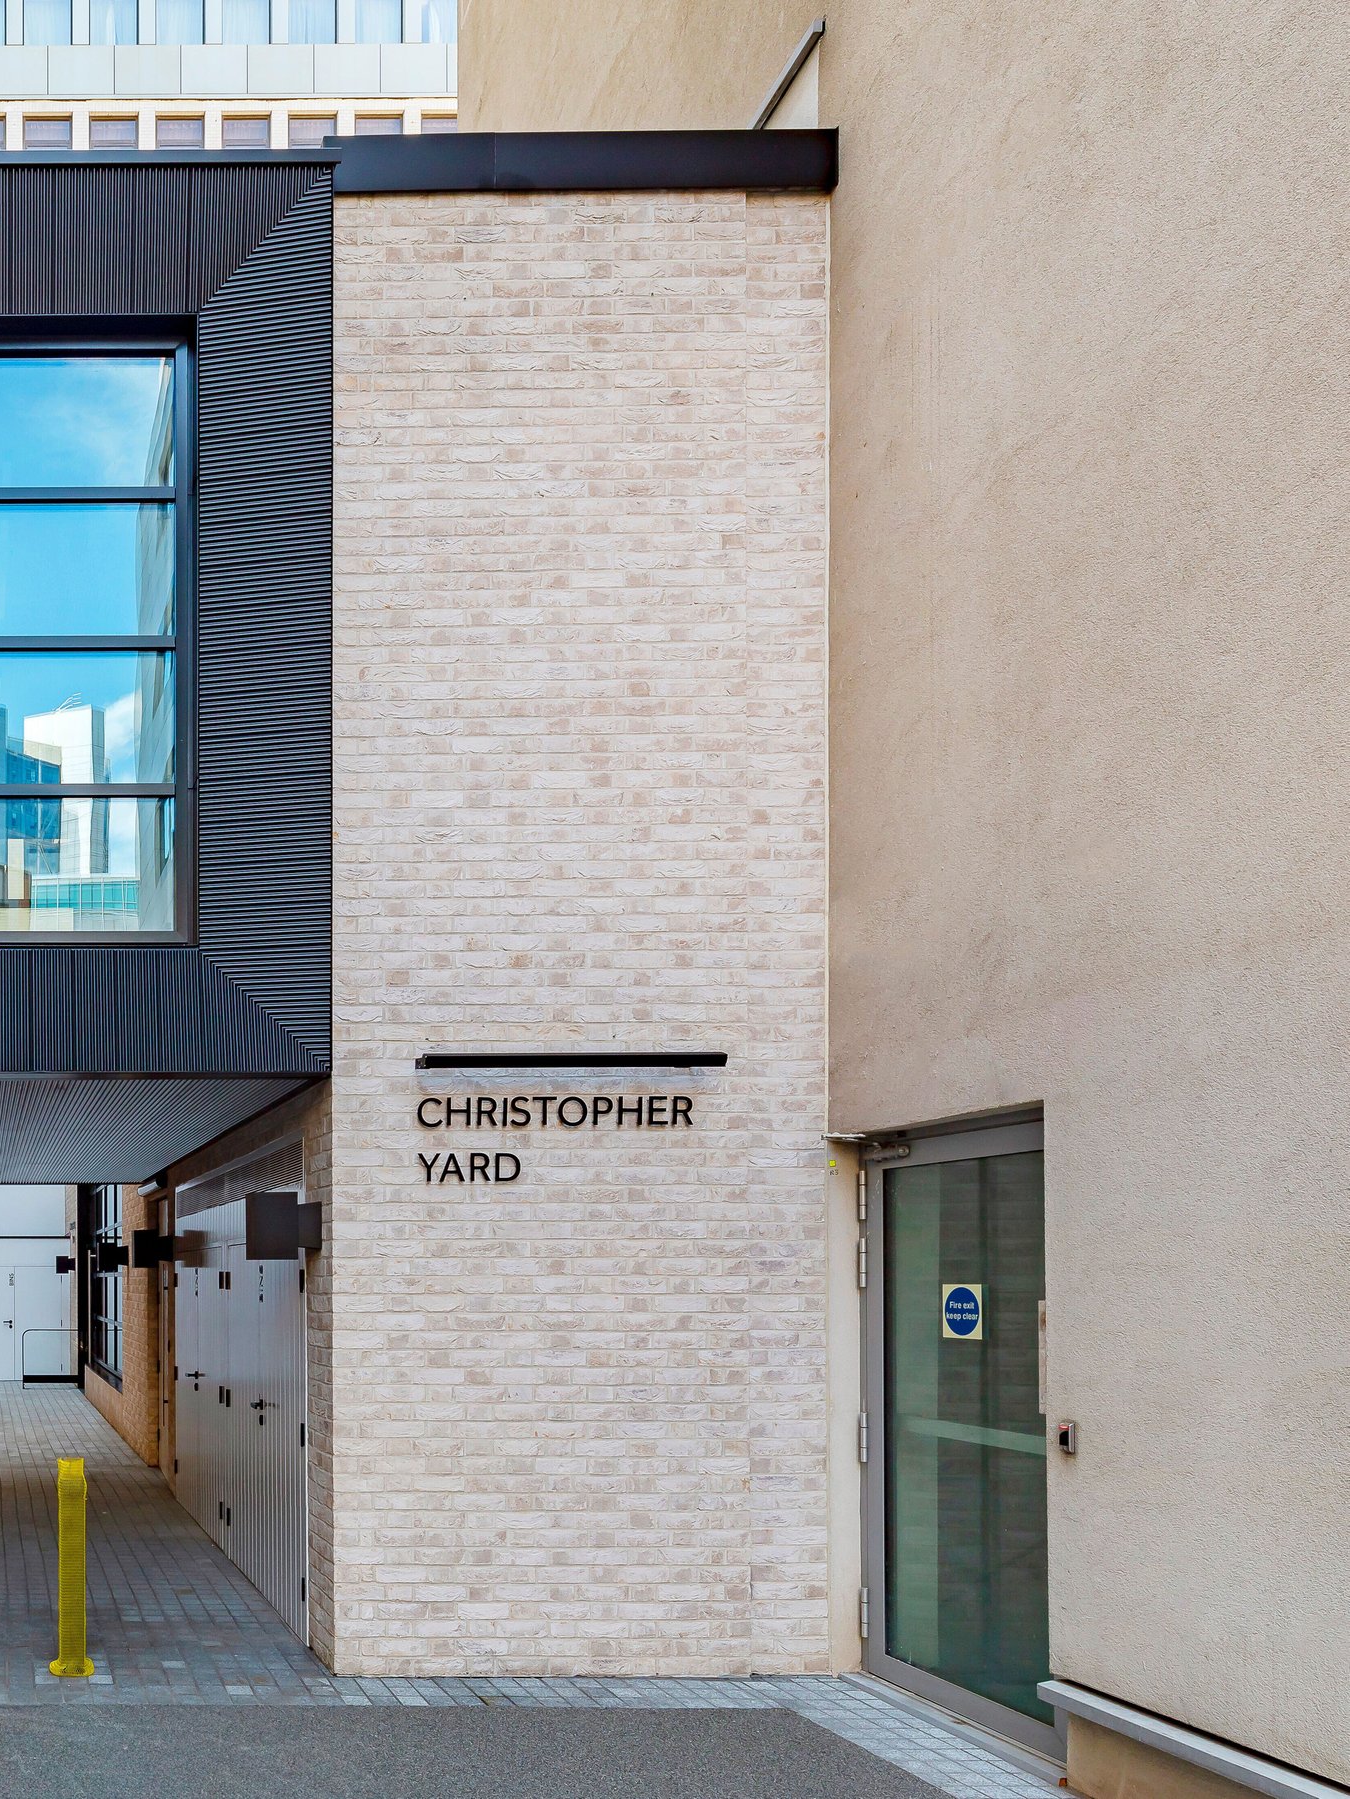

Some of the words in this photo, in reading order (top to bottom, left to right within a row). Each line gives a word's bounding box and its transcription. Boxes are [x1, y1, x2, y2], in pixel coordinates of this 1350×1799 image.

[417, 1096, 694, 1128] CHRISTOPHER
[418, 1152, 522, 1183] YARD
[949, 1301, 962, 1309] Fire
[946, 1312, 962, 1321] keep
[962, 1312, 978, 1321] clear
